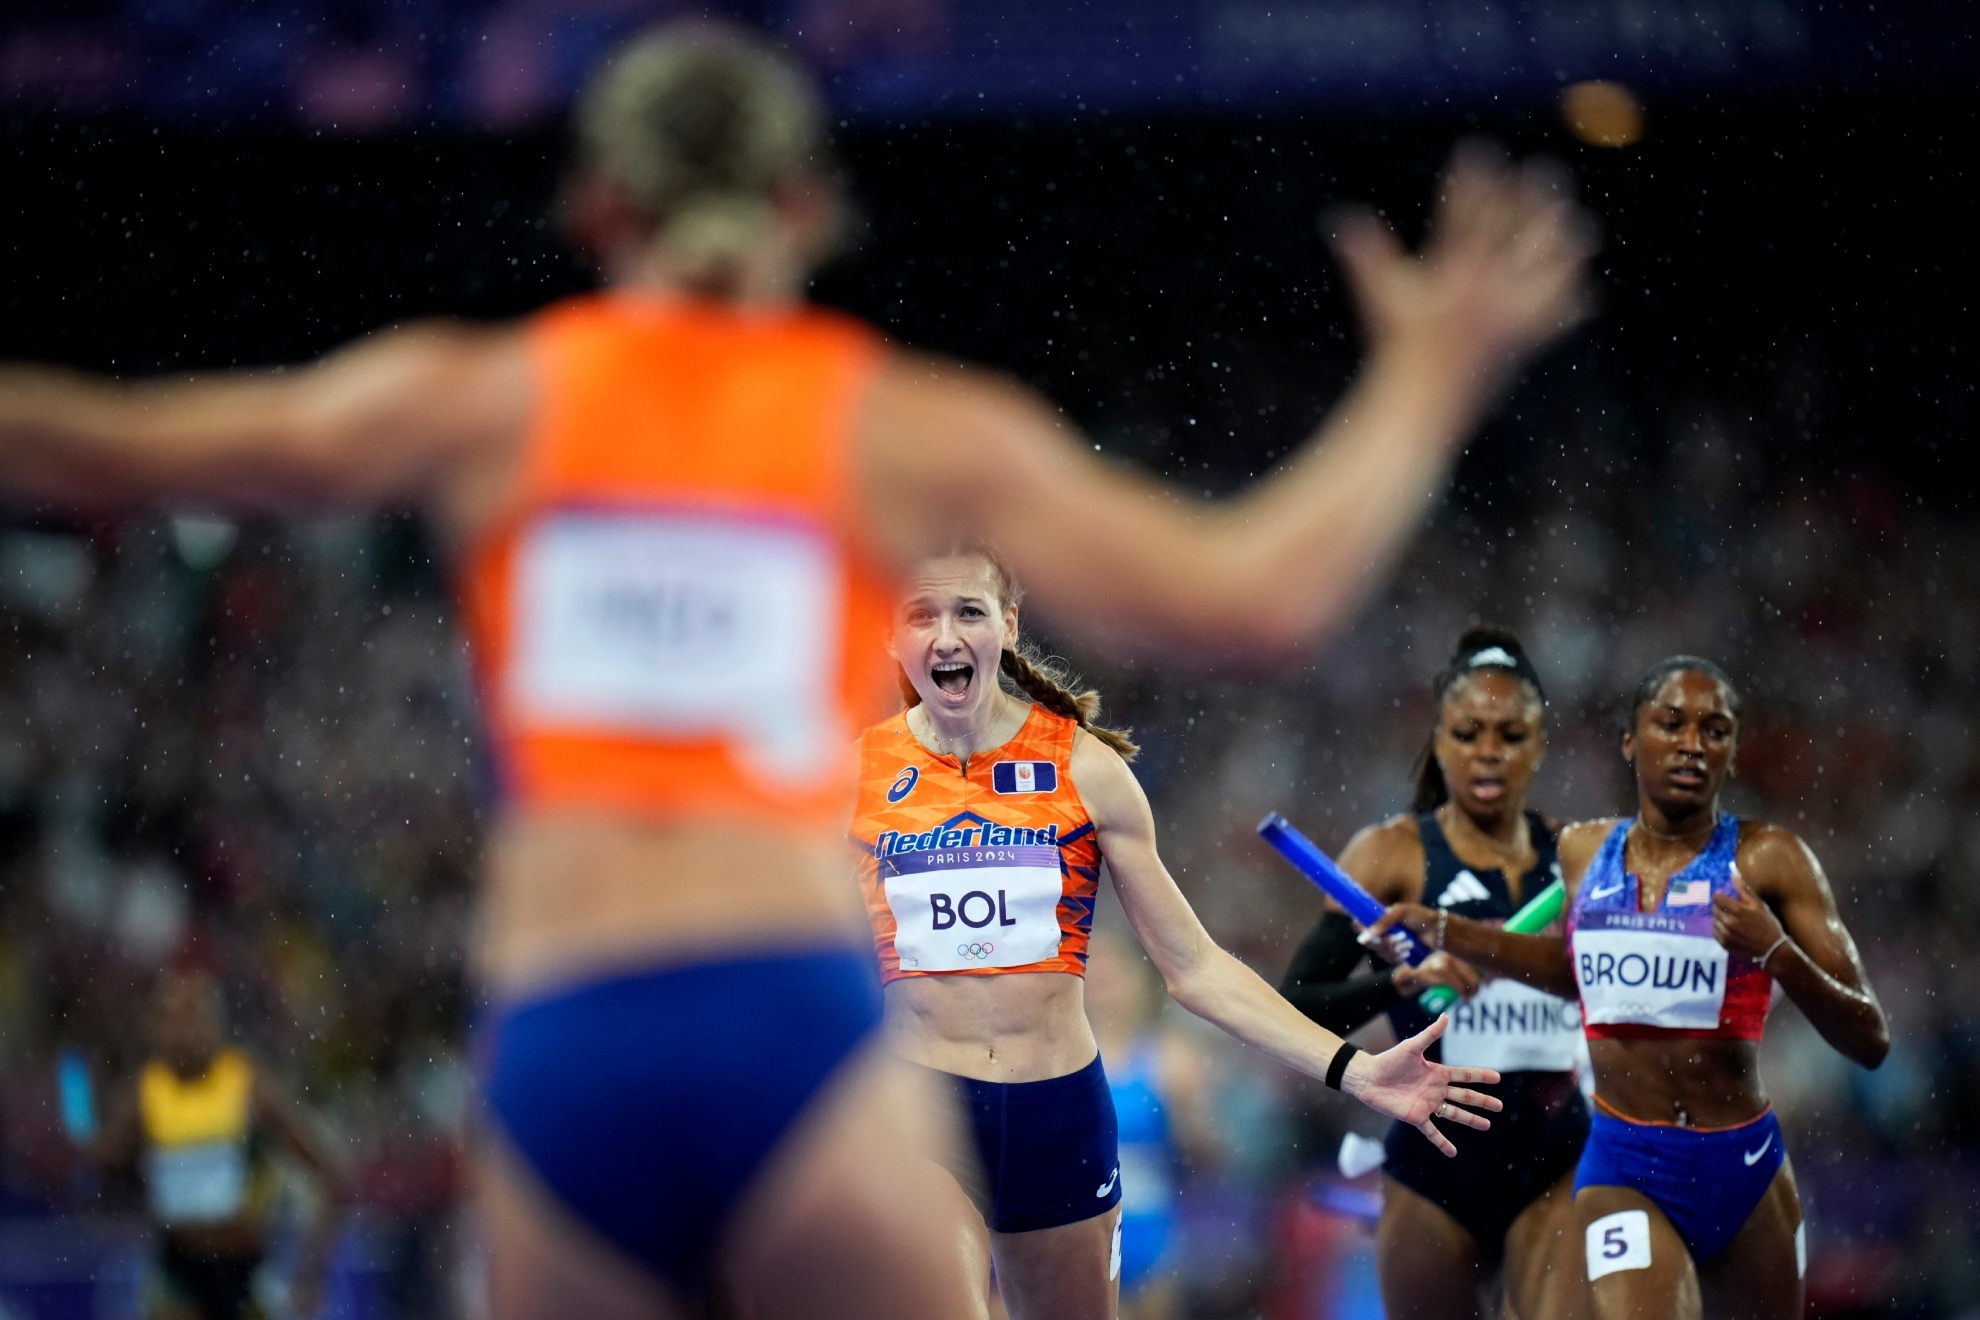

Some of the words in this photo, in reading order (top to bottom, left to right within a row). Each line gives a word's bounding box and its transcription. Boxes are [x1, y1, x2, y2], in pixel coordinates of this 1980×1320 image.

[928, 852, 970, 866] PARIS
[976, 850, 1015, 862] 2024
[930, 890, 1016, 930] BOL
[1581, 953, 1717, 993] BROWN
[1602, 1227, 1629, 1259] 5
